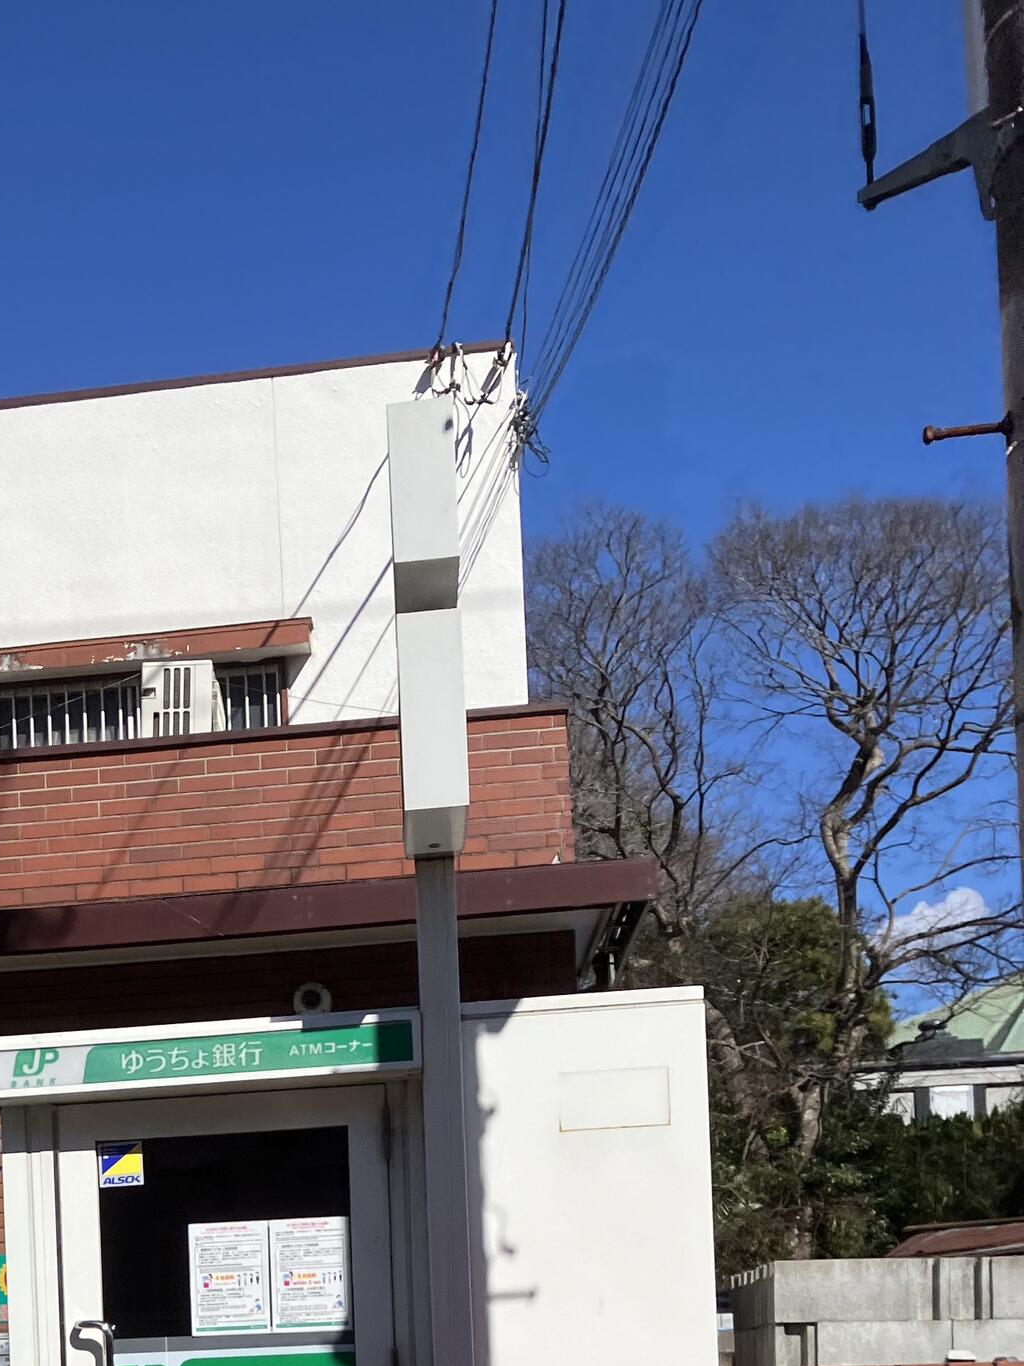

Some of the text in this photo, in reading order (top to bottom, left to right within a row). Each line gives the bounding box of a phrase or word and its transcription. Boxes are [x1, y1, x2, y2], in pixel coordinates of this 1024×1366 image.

[121, 1040, 375, 1075] ゆうちょ銀行 ATMコーナー
[102, 1175, 142, 1186] ALSOK
